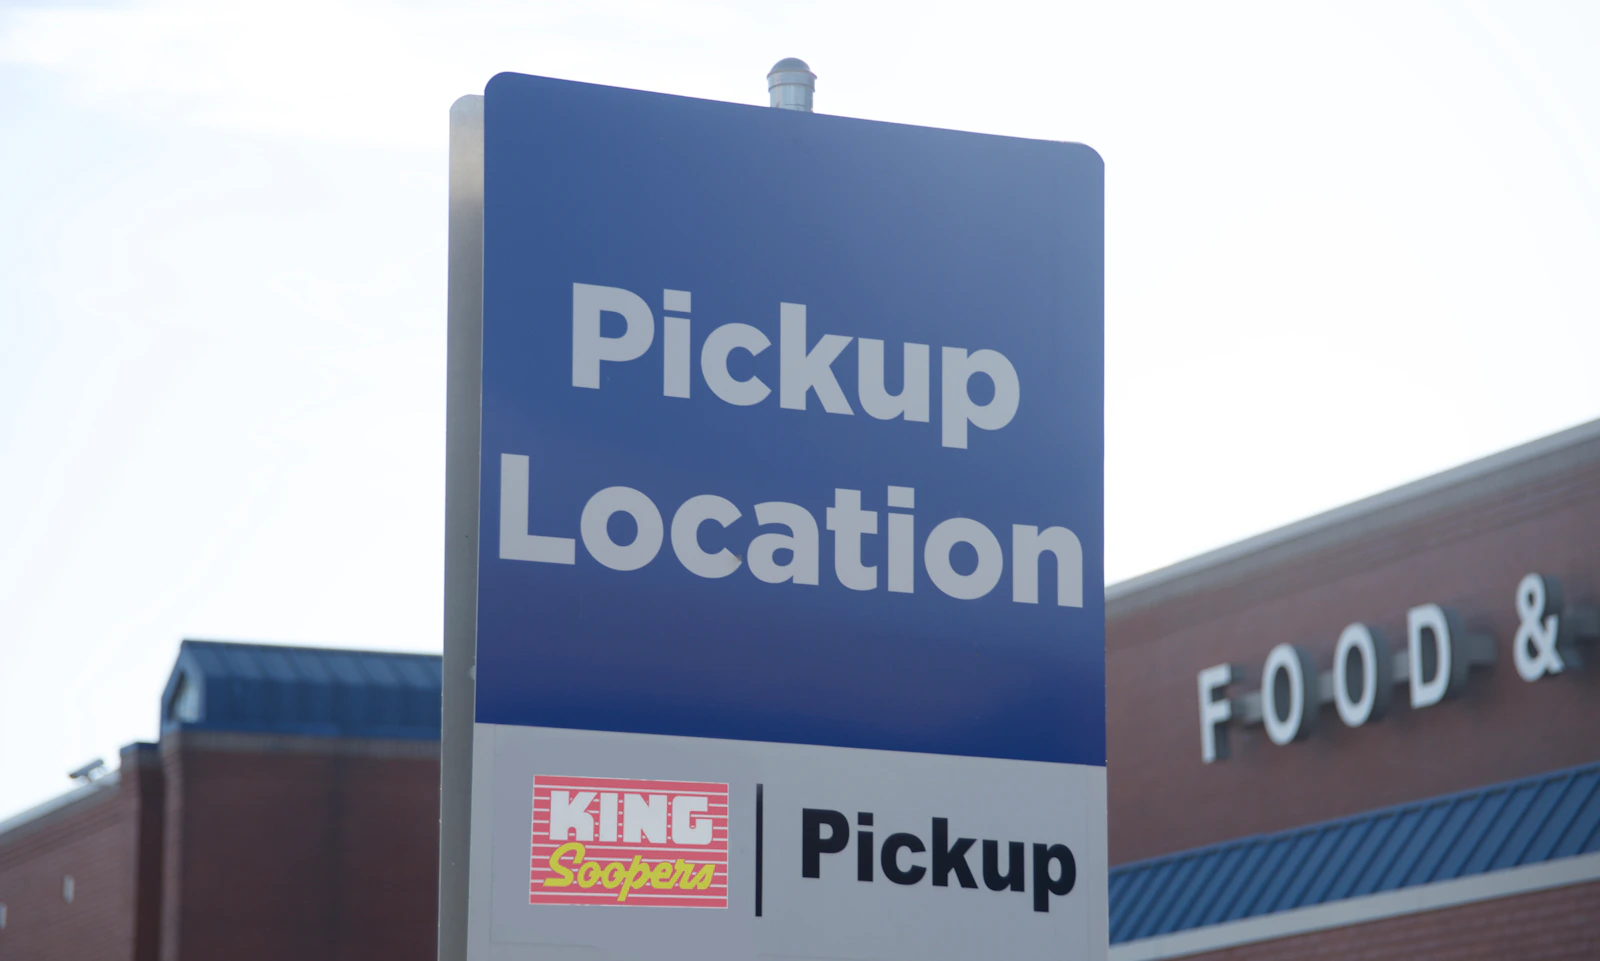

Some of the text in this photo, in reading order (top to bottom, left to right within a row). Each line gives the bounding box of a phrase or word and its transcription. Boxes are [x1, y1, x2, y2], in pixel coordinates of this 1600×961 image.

[572, 282, 1020, 449] Pickup
[499, 452, 1084, 608] Location
[1197, 572, 1565, 763] FOOD &
[542, 842, 716, 901] Soopers
[549, 789, 713, 845] KING
[802, 808, 1077, 913] Pickup
